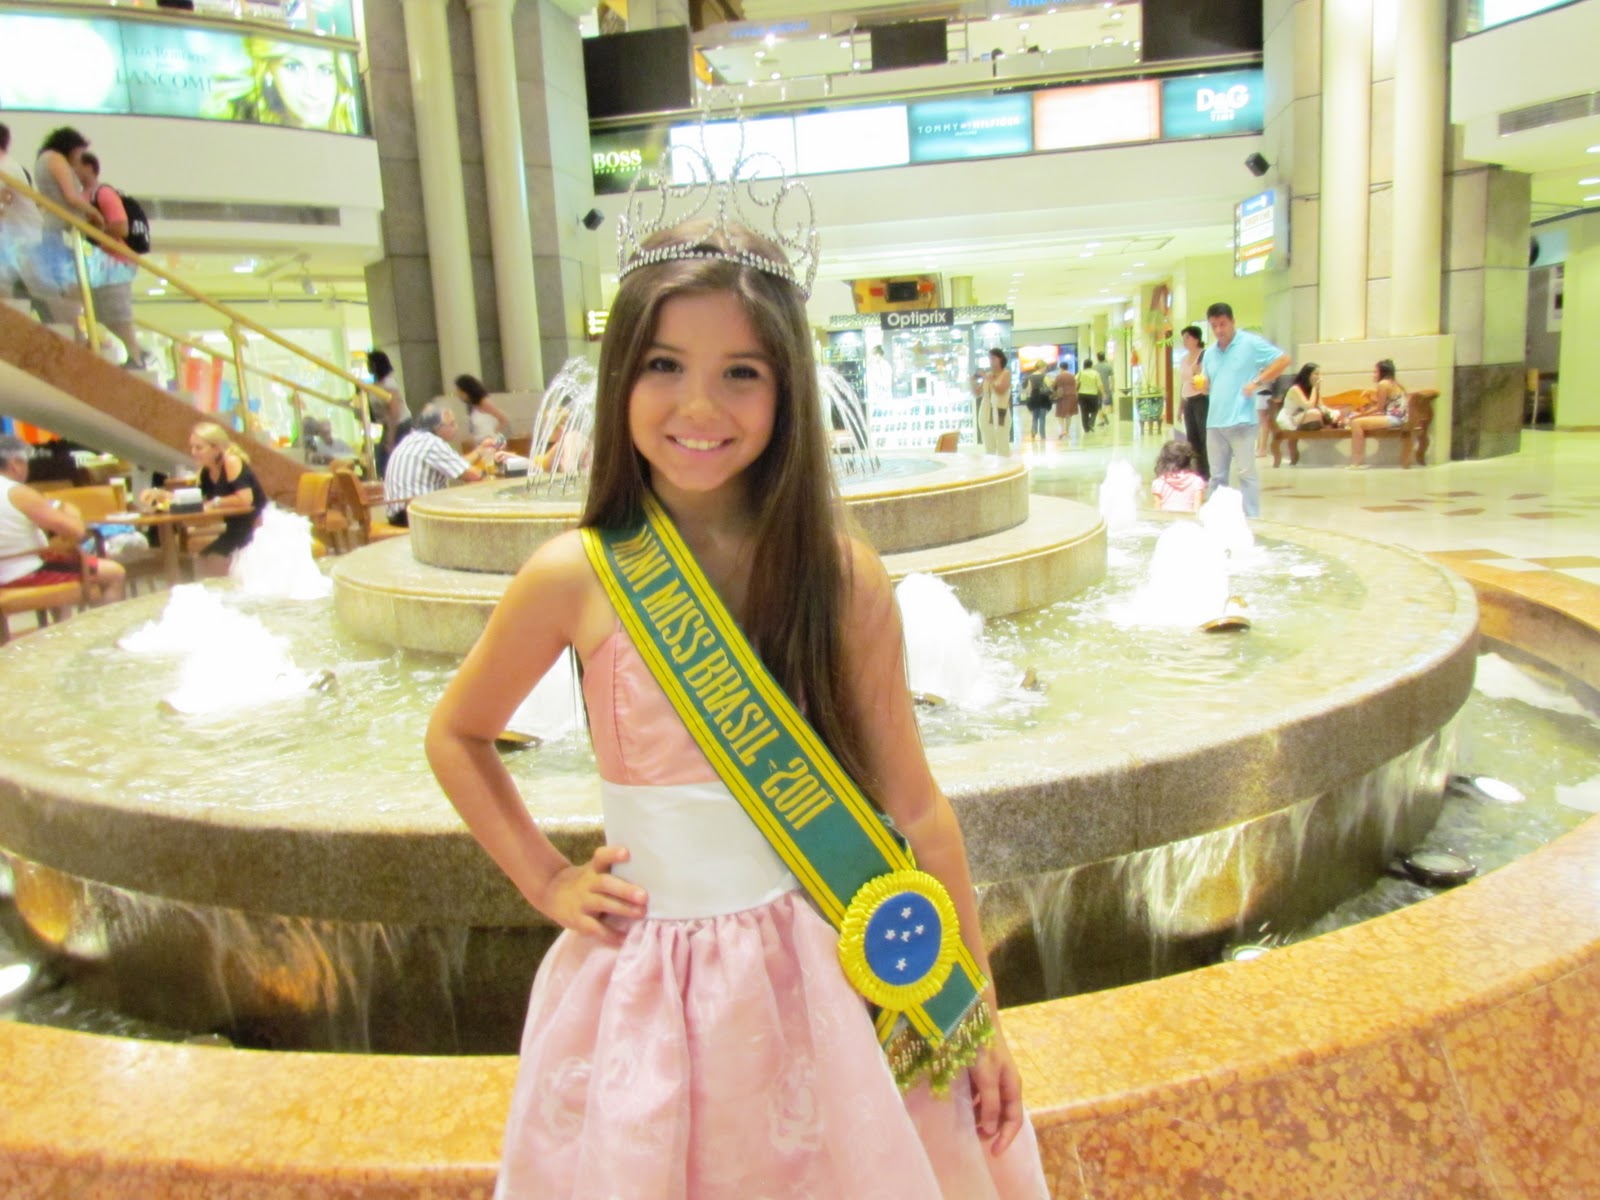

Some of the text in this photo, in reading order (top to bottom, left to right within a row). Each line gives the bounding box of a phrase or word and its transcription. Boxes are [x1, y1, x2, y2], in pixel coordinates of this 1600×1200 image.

[917, 123, 958, 134] TOMMY
[593, 149, 642, 170] BOSS
[887, 309, 947, 328] Optiprix
[610, 524, 673, 594] MINI
[641, 577, 717, 666] MISS
[682, 646, 781, 768] BRASIL
